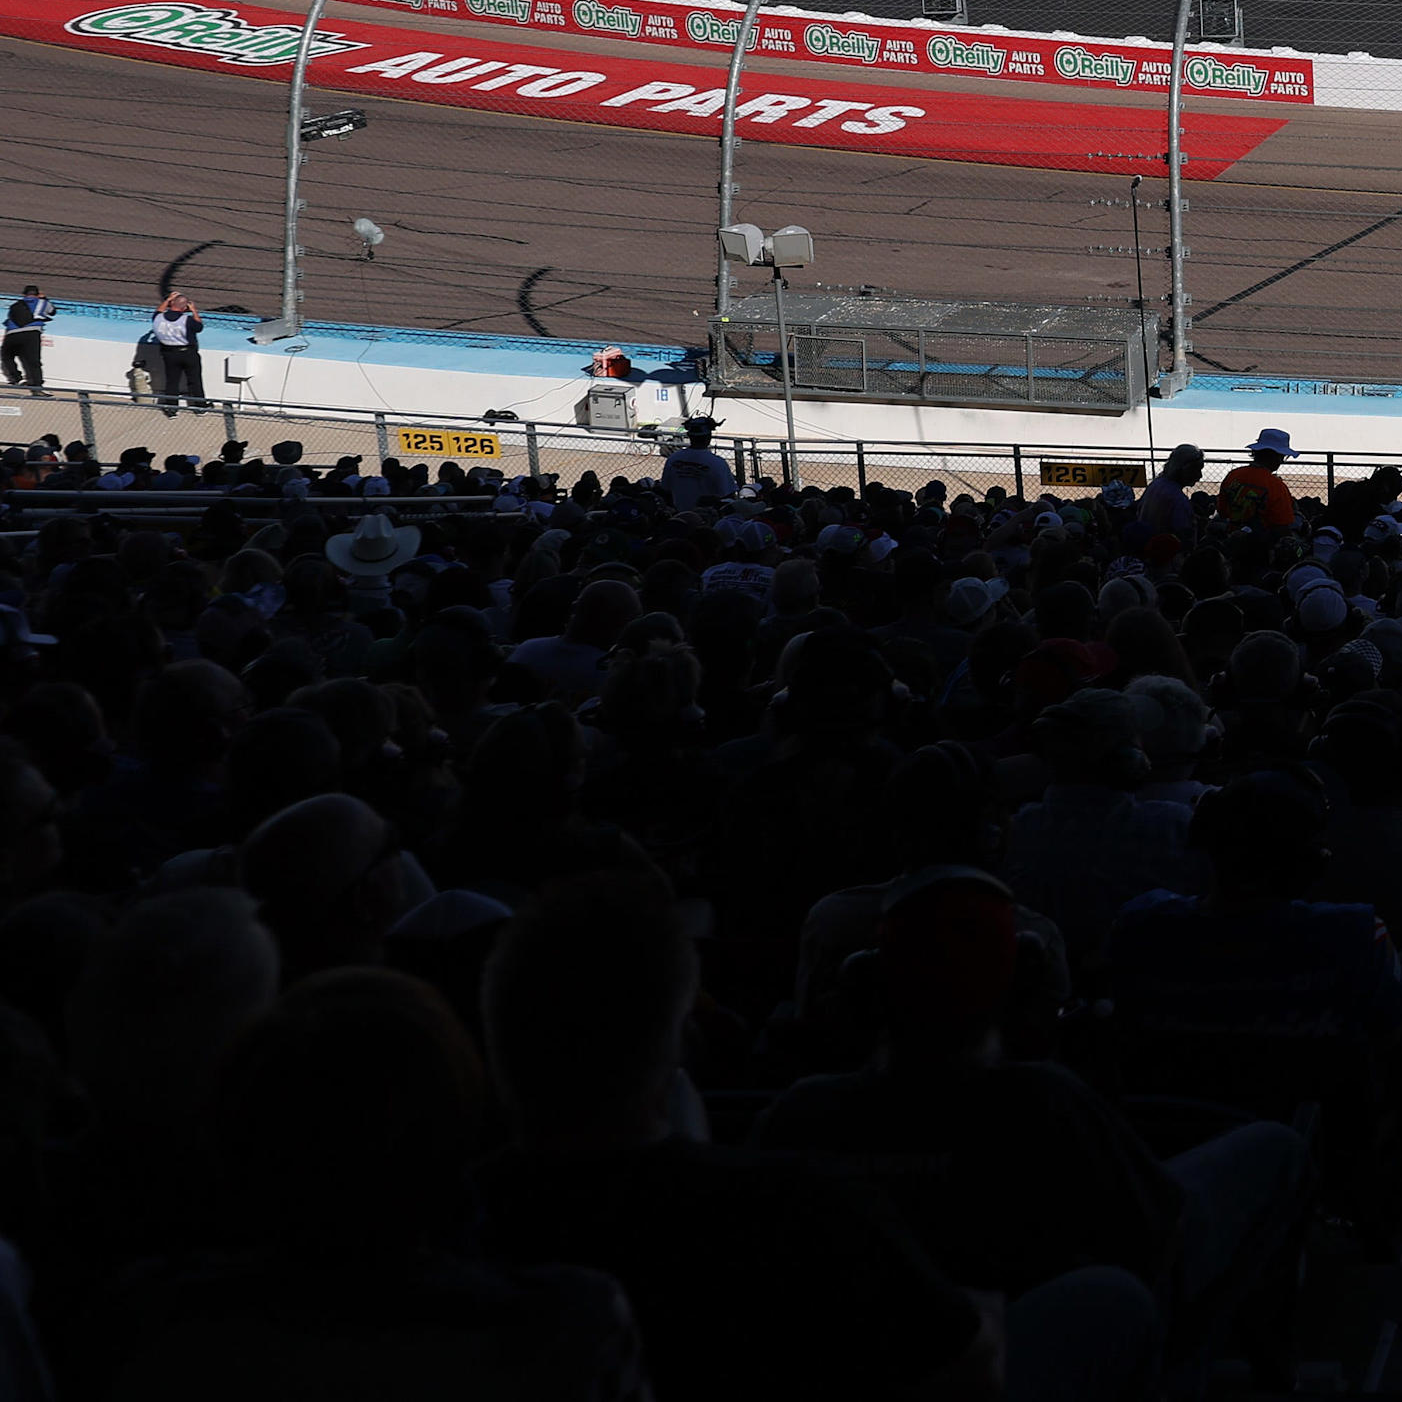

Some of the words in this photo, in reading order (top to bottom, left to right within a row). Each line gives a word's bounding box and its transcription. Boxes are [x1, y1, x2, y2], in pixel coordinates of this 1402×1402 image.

[648, 14, 674, 27] AUTO
[646, 26, 678, 39] PARTS
[805, 24, 881, 64] O'Reilly
[886, 39, 914, 52] AUTO
[883, 50, 918, 64] PARTS
[928, 35, 1007, 74] O'Reilly
[1011, 51, 1040, 64] AUTO
[75, 3, 340, 64] O'Reilly
[345, 50, 607, 99] AUTO
[600, 81, 926, 135] PARTS
[1009, 62, 1045, 76] PARTS
[1185, 56, 1268, 96] O'Reilly
[1274, 71, 1305, 84] AUTO
[1271, 83, 1309, 96] PARTS
[401, 432, 443, 451] 125
[453, 436, 495, 455] 126
[1043, 465, 1088, 484] 126
[1099, 466, 1140, 485] 127
